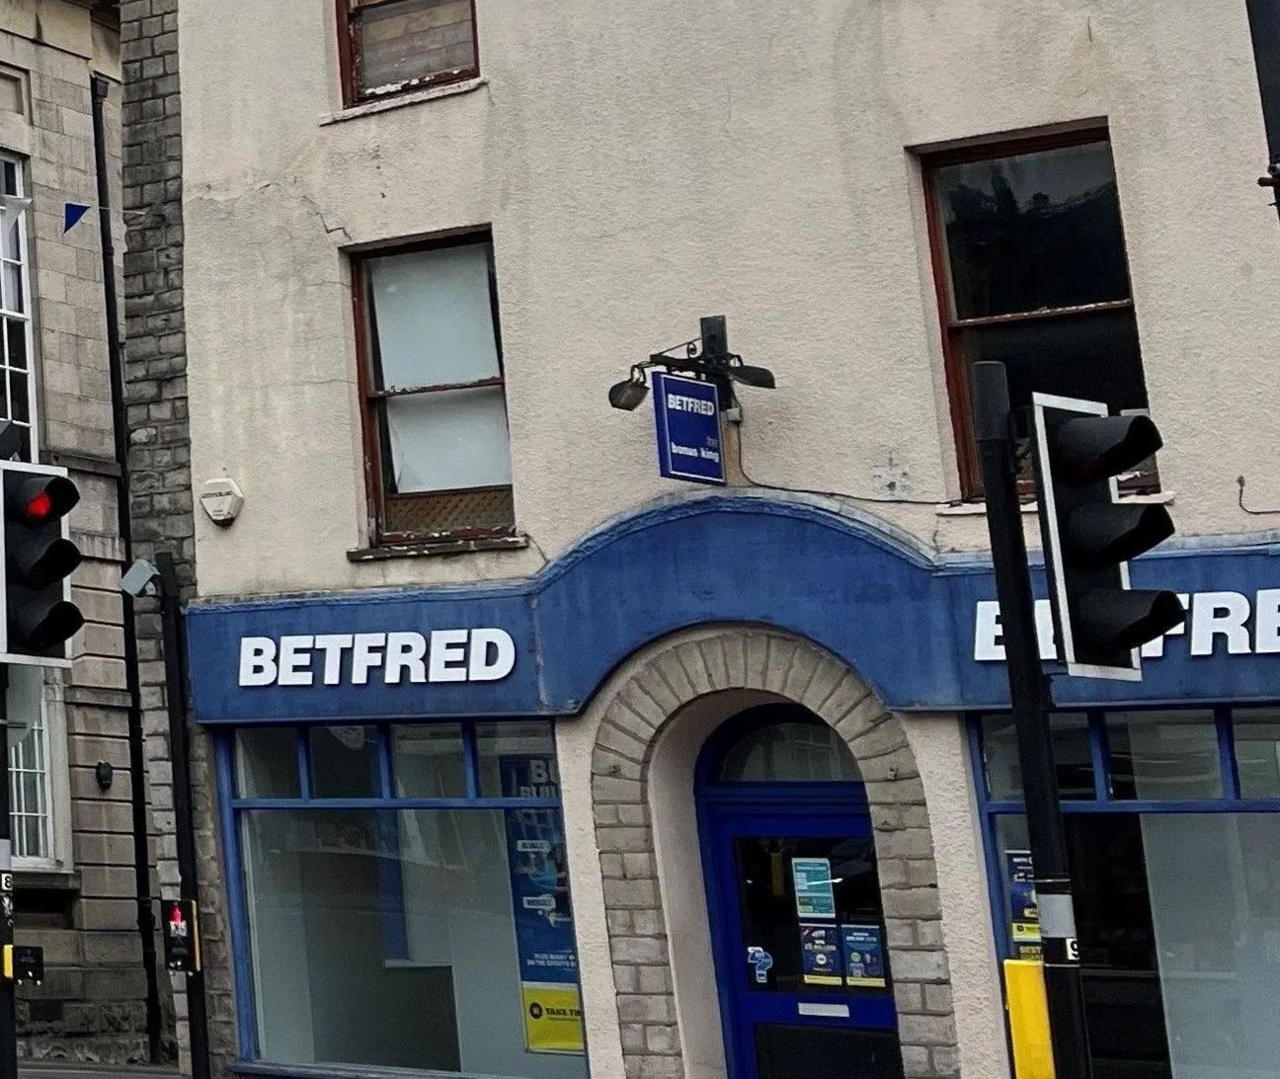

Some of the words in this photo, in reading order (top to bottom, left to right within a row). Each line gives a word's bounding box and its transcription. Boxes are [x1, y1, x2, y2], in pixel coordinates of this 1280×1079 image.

[668, 393, 715, 416] BETFRED
[239, 628, 516, 687] BETFRED
[4, 875, 13, 889] 8
